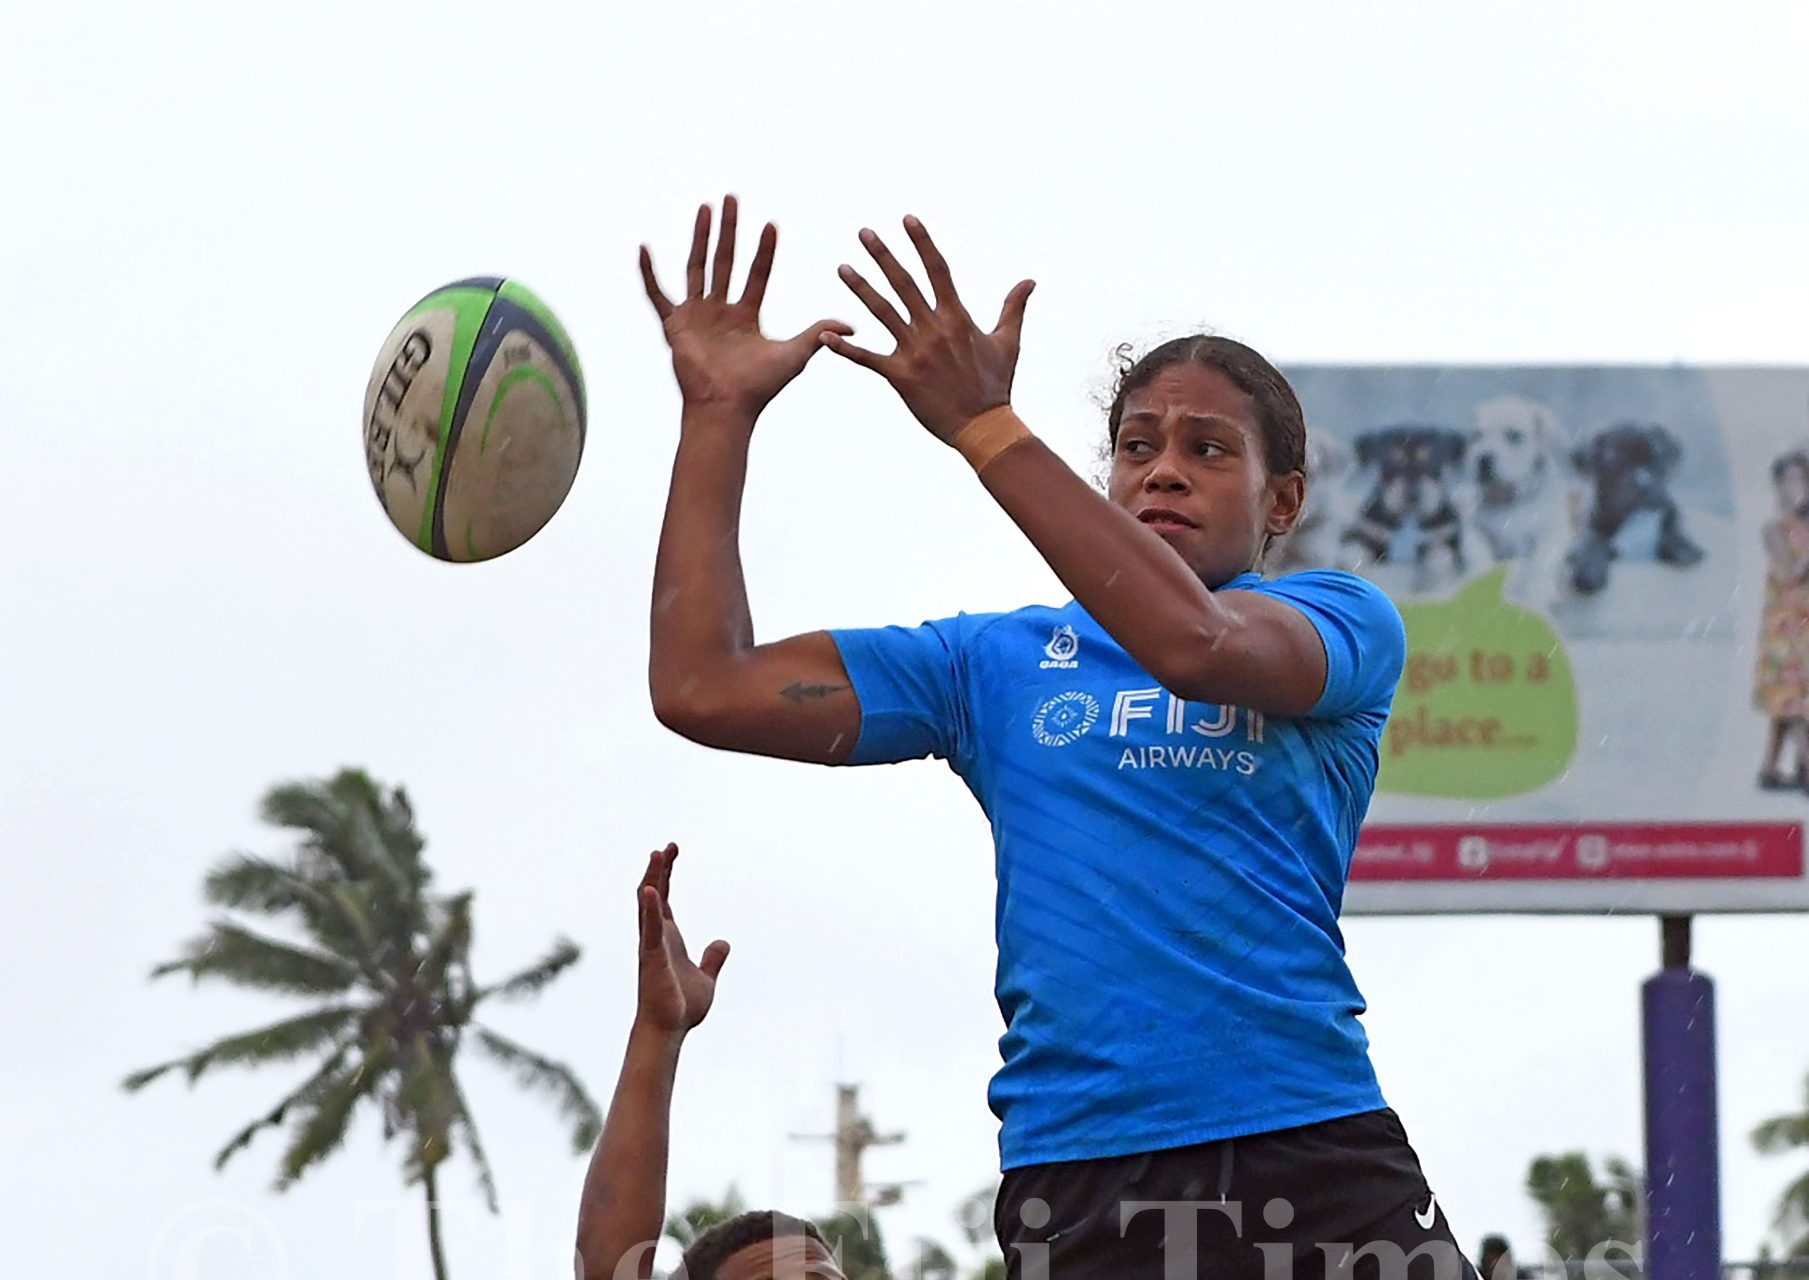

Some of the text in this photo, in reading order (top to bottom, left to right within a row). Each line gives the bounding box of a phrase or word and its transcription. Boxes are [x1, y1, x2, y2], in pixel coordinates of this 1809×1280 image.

[1469, 650, 1514, 682] to
[1527, 653, 1550, 682] a
[1109, 687, 1264, 743] FIJI
[1118, 746, 1255, 775] AIRWAYS
